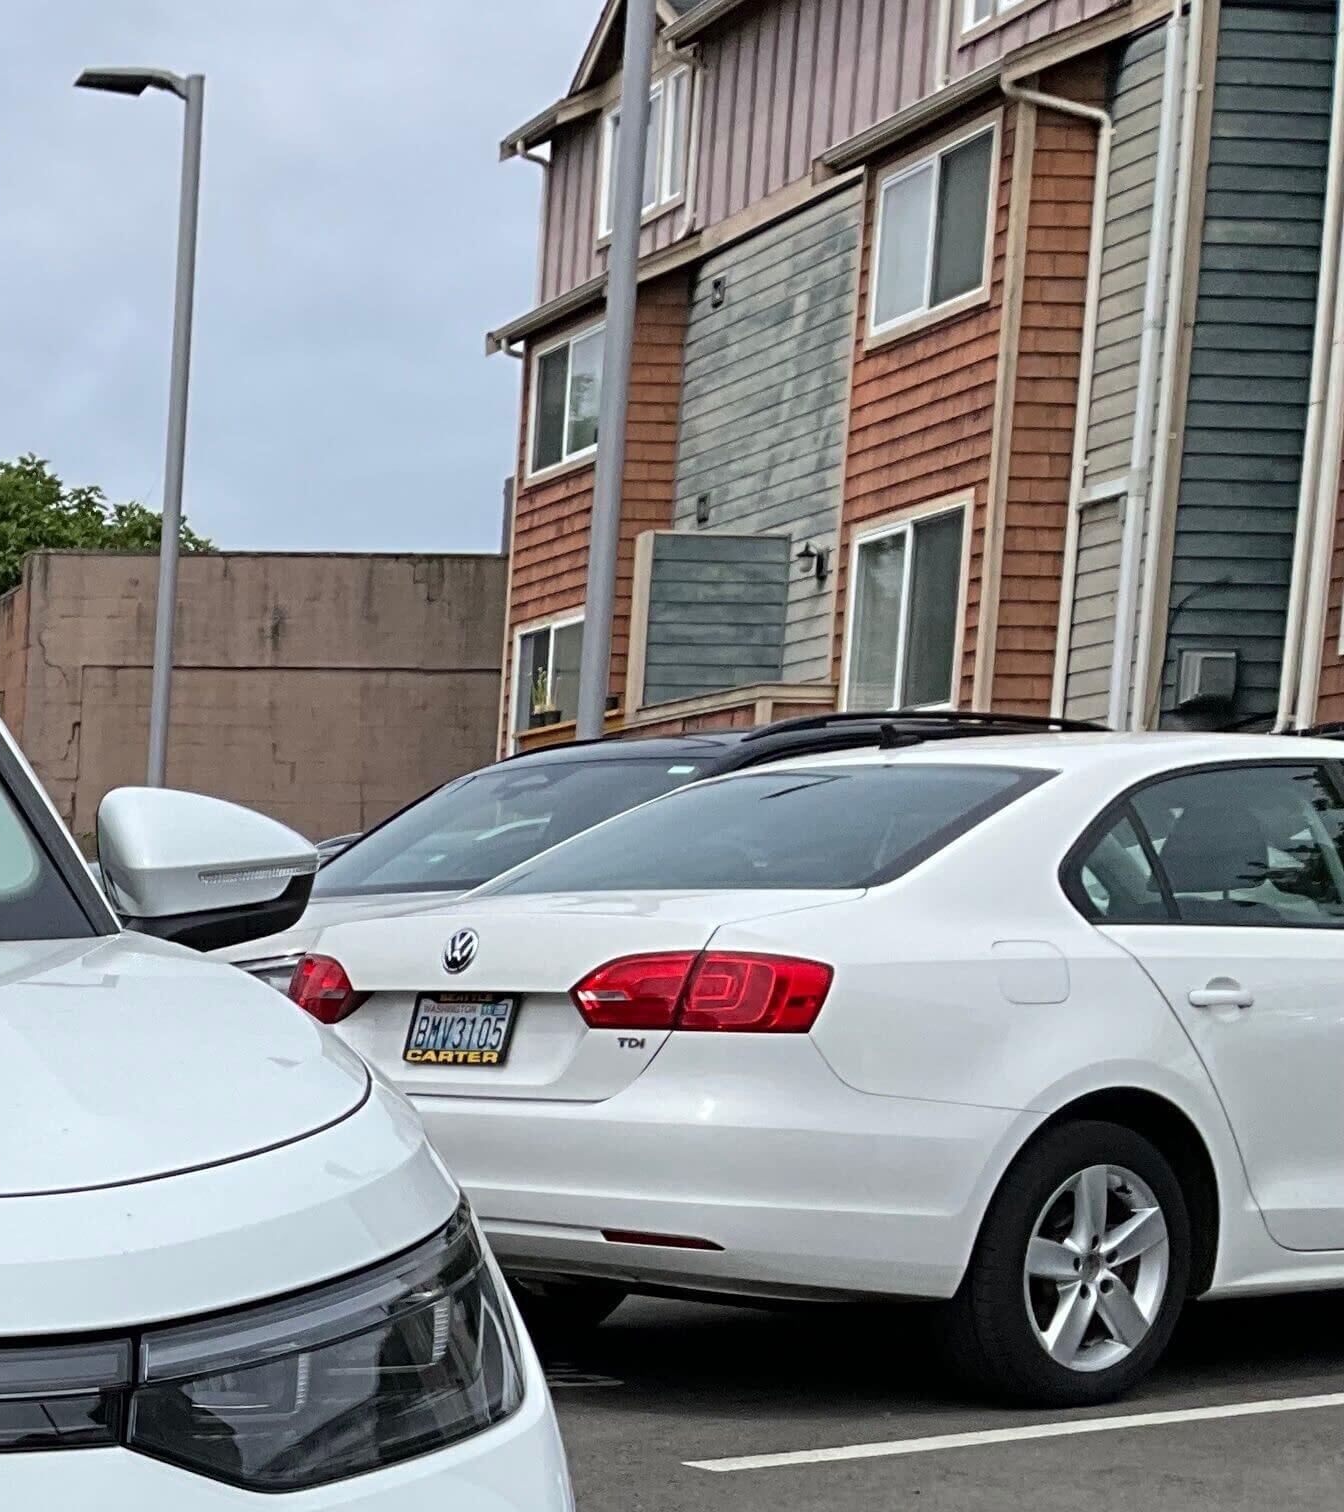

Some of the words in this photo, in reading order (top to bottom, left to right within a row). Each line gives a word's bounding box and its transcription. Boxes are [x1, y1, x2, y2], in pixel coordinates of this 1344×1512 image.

[423, 1004, 476, 1014] WASHINGTON
[414, 1016, 506, 1050] BMV3105
[617, 1037, 646, 1050] TDI
[406, 1049, 499, 1064] CARTER
